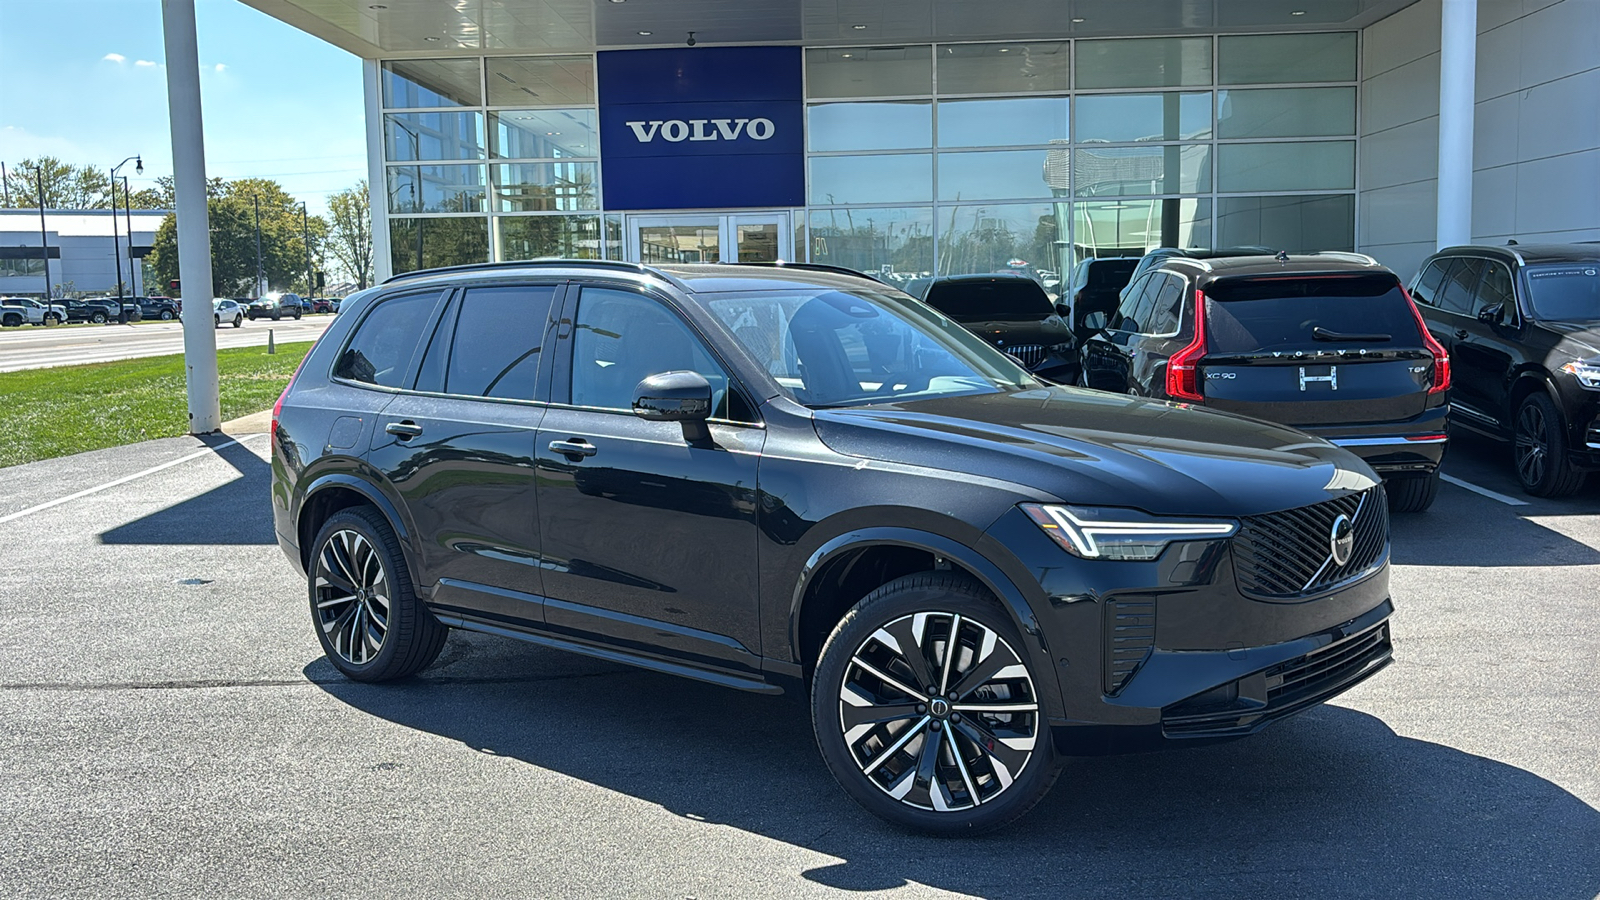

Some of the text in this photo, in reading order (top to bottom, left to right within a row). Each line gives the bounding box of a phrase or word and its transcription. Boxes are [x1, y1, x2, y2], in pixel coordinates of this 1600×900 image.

[625, 117, 776, 143] VOLVO
[1272, 348, 1367, 358] VOLVO
[1205, 372, 1237, 380] XC90
